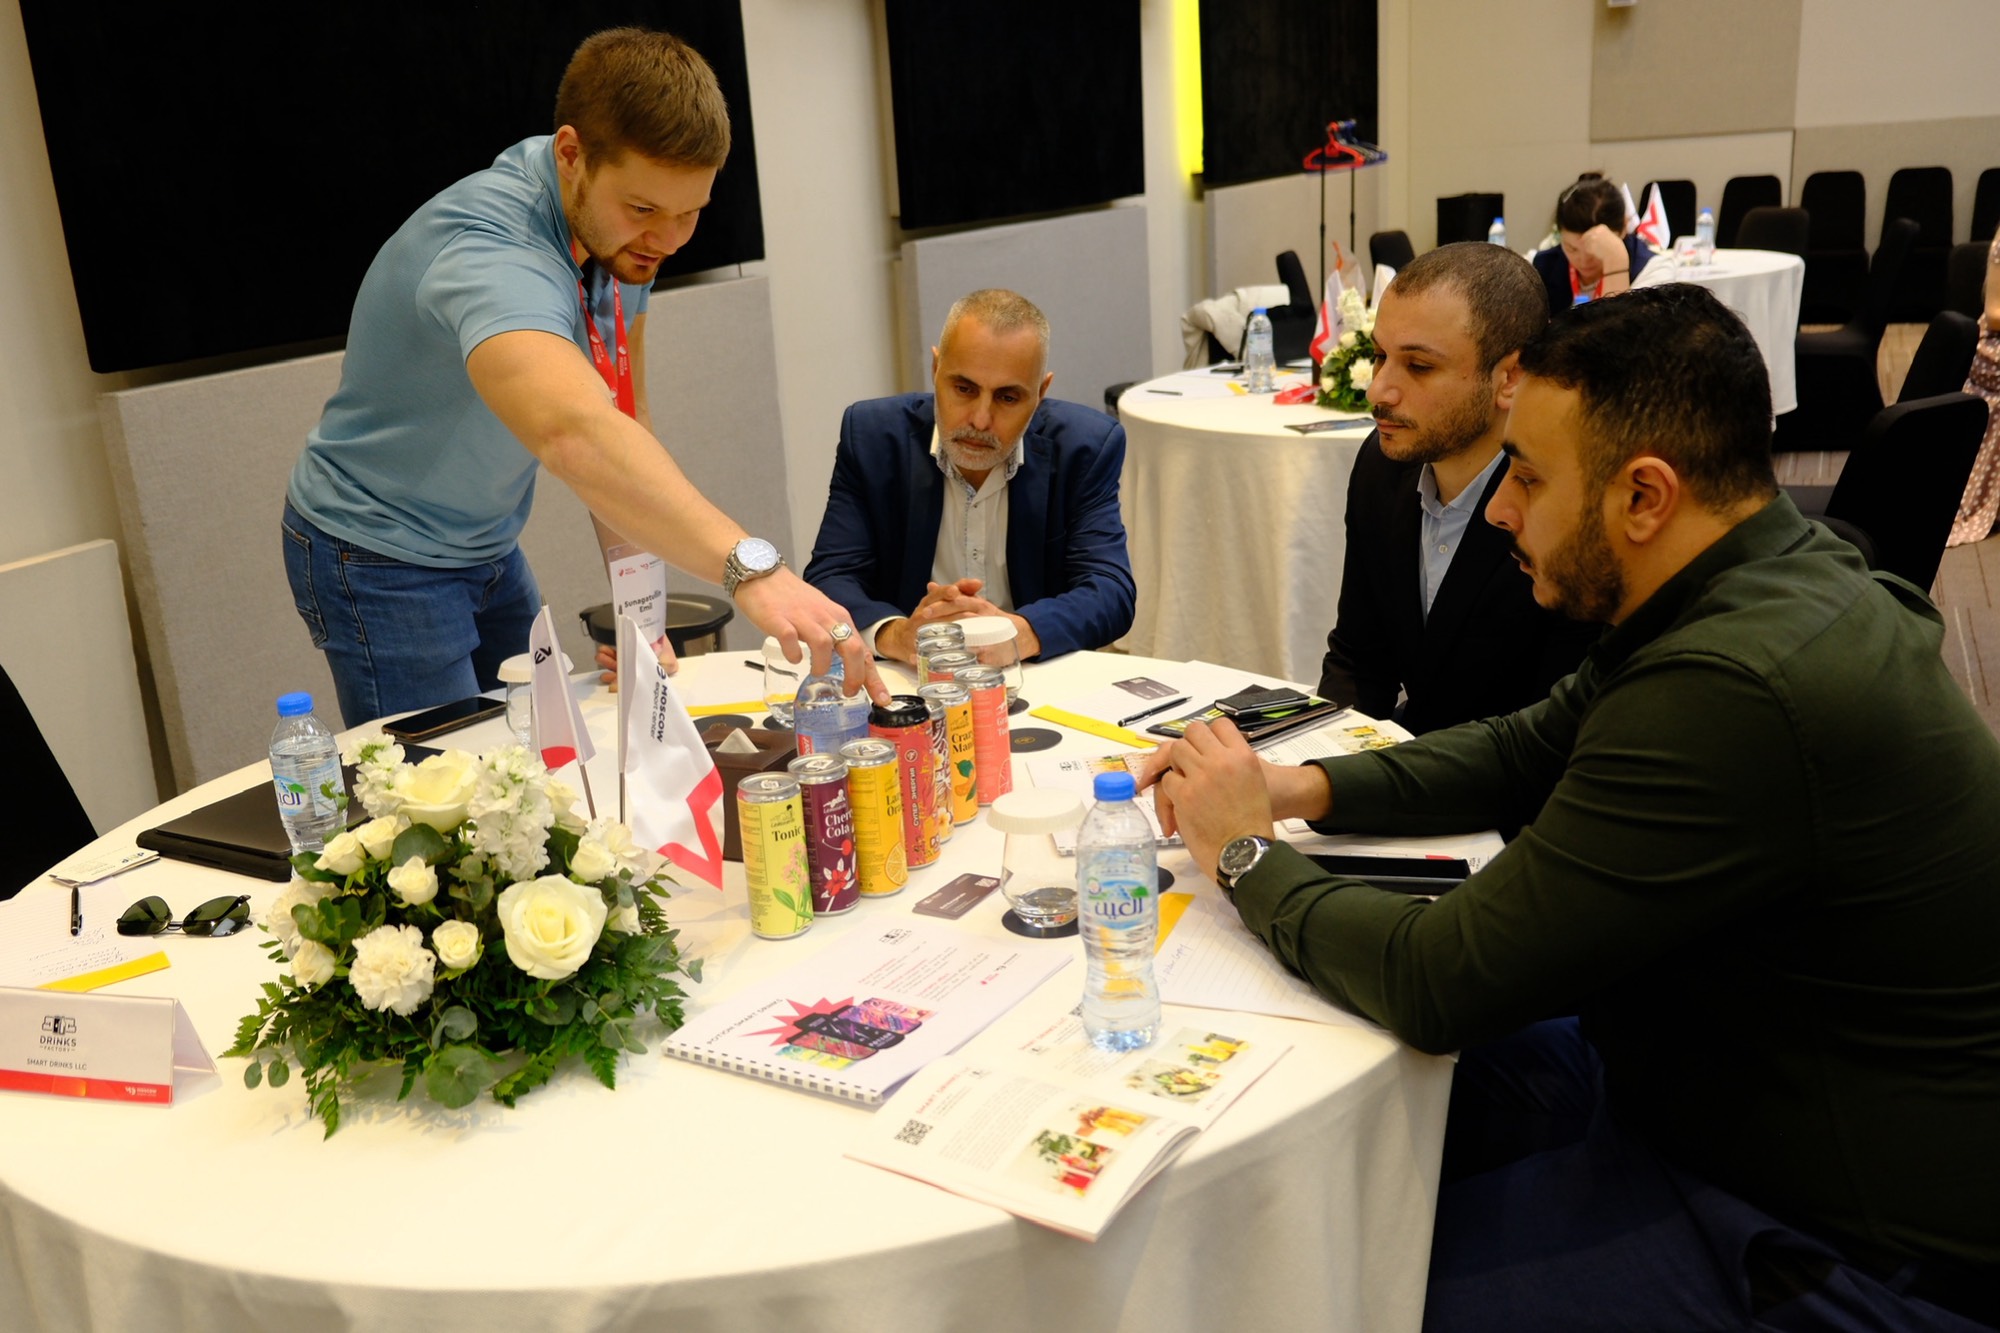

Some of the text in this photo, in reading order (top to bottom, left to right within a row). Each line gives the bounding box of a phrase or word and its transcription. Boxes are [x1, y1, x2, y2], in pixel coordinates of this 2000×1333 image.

[650, 681, 661, 739] export center
[656, 684, 668, 743] MOSCOW
[951, 730, 974, 744] Craz
[951, 742, 974, 755] Man
[909, 767, 920, 827] СУПЕР ЭНЕРГИЯ
[824, 809, 853, 827] Cherr
[771, 825, 802, 842] Tonic
[825, 824, 850, 839] Cola
[1094, 897, 1143, 920] العين
[39, 1035, 77, 1047] DRINKS
[26, 1058, 88, 1071] SMART DRINKS LLC
